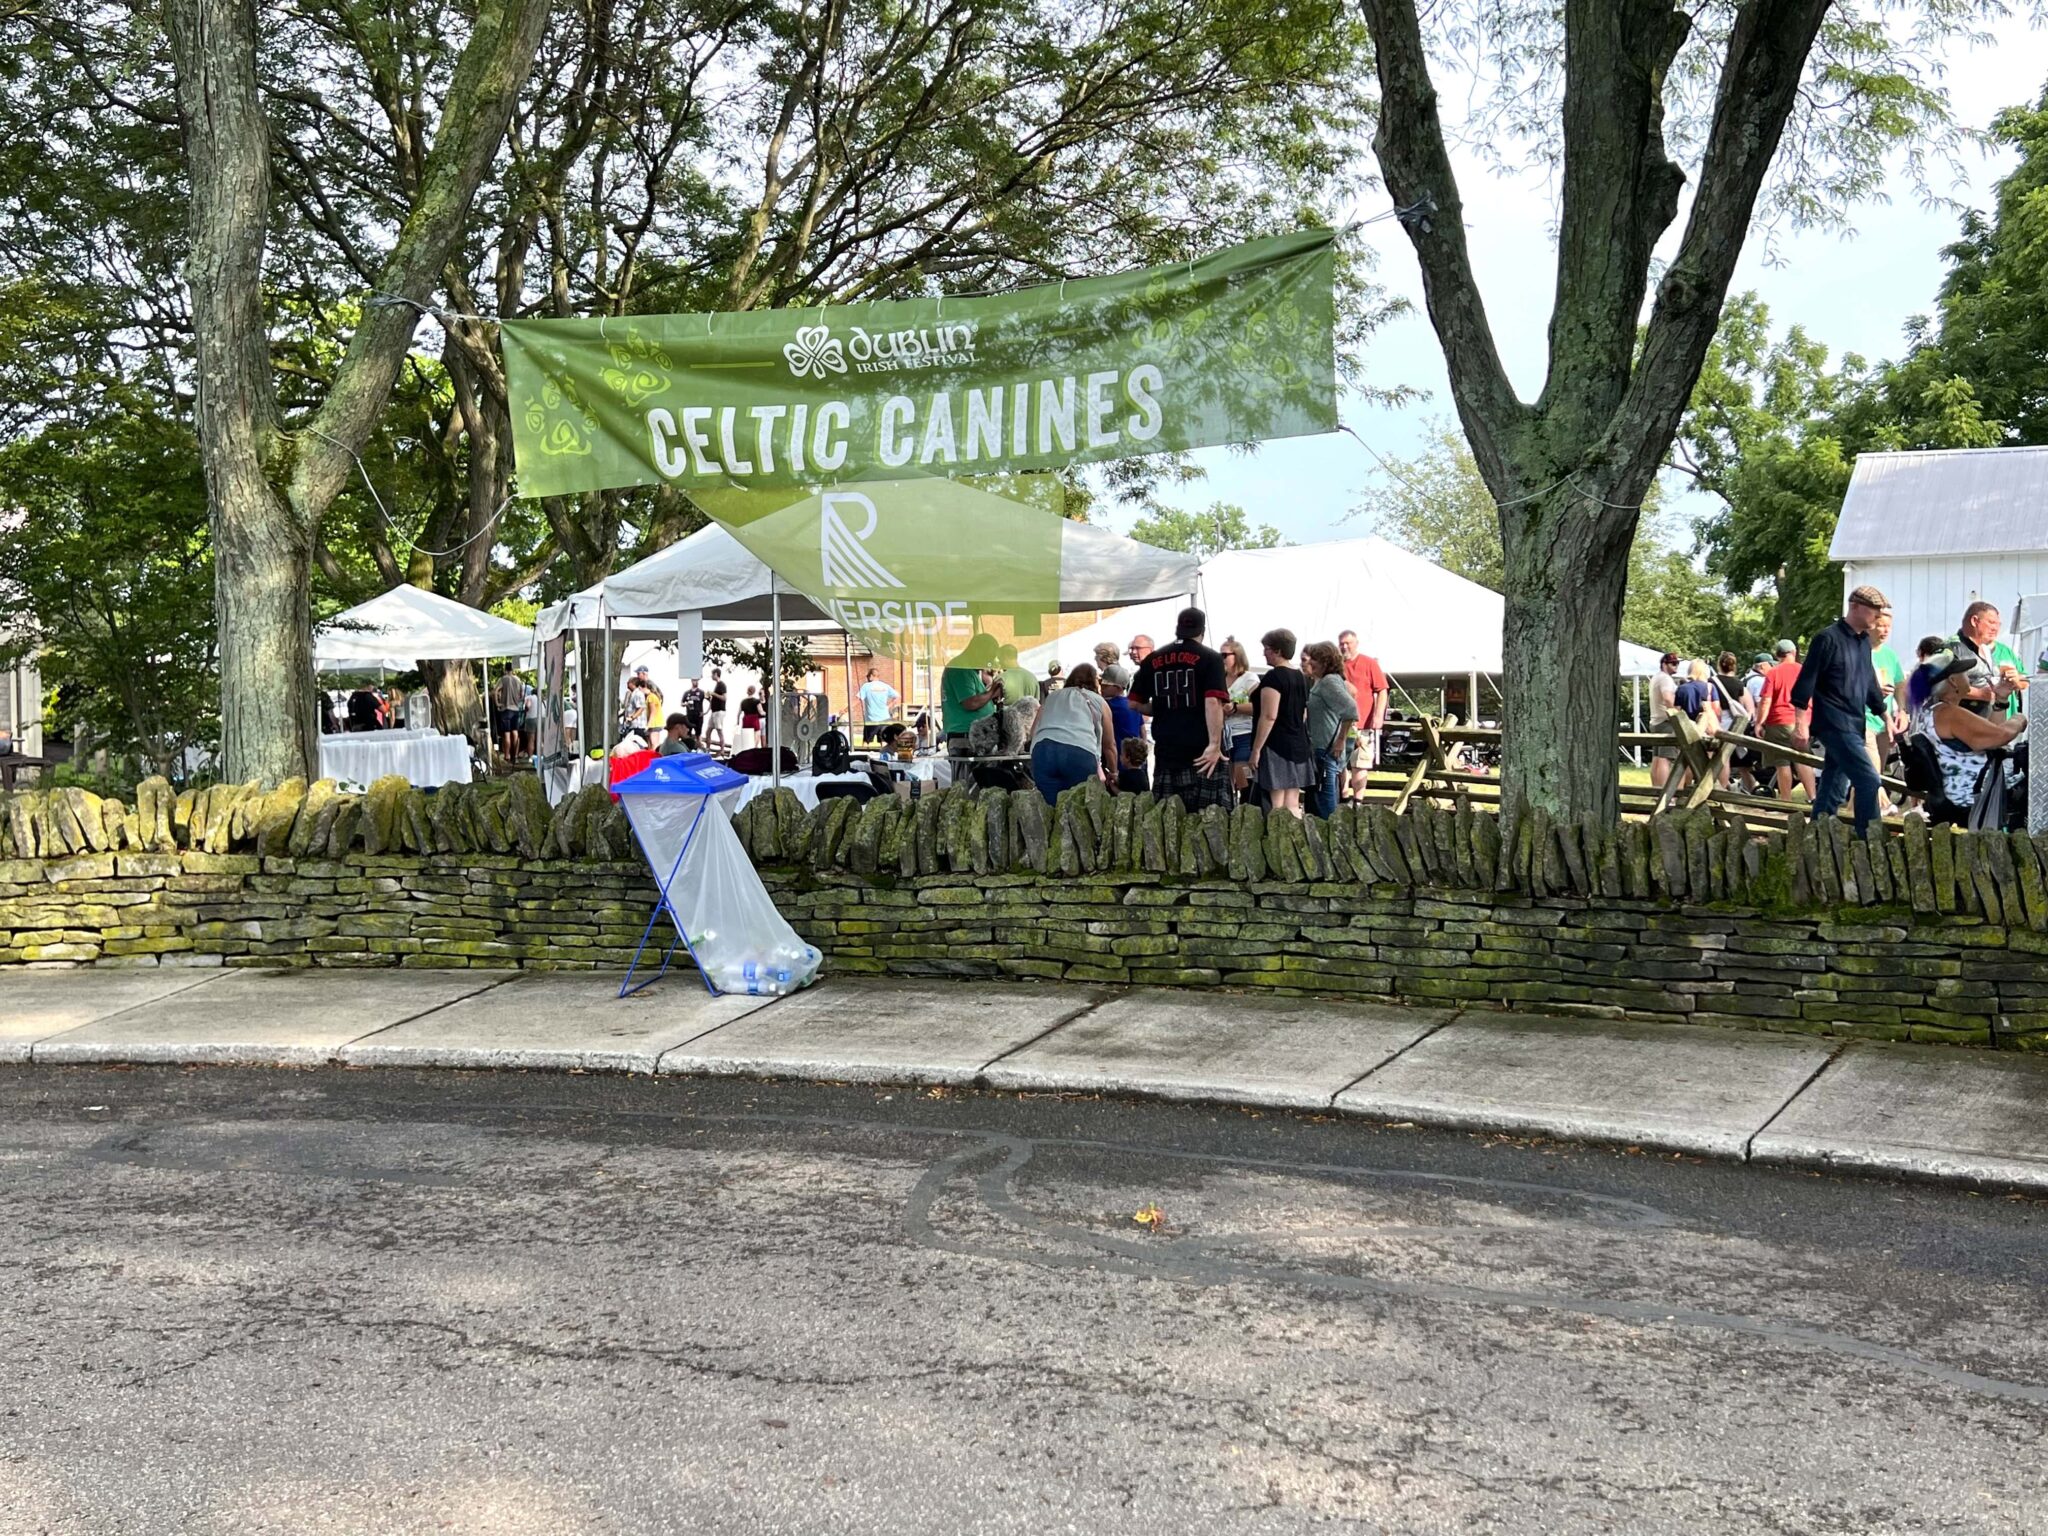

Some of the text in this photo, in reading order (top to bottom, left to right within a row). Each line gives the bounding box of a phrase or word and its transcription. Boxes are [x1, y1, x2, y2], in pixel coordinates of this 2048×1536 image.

[856, 352, 980, 374] IRISH FESTIVAL
[646, 363, 1164, 478] CELTIC CANINES
[809, 594, 970, 636] VERSIDE
[1152, 652, 1200, 669] DE LA CRUZ
[1154, 668, 1197, 710] 44
